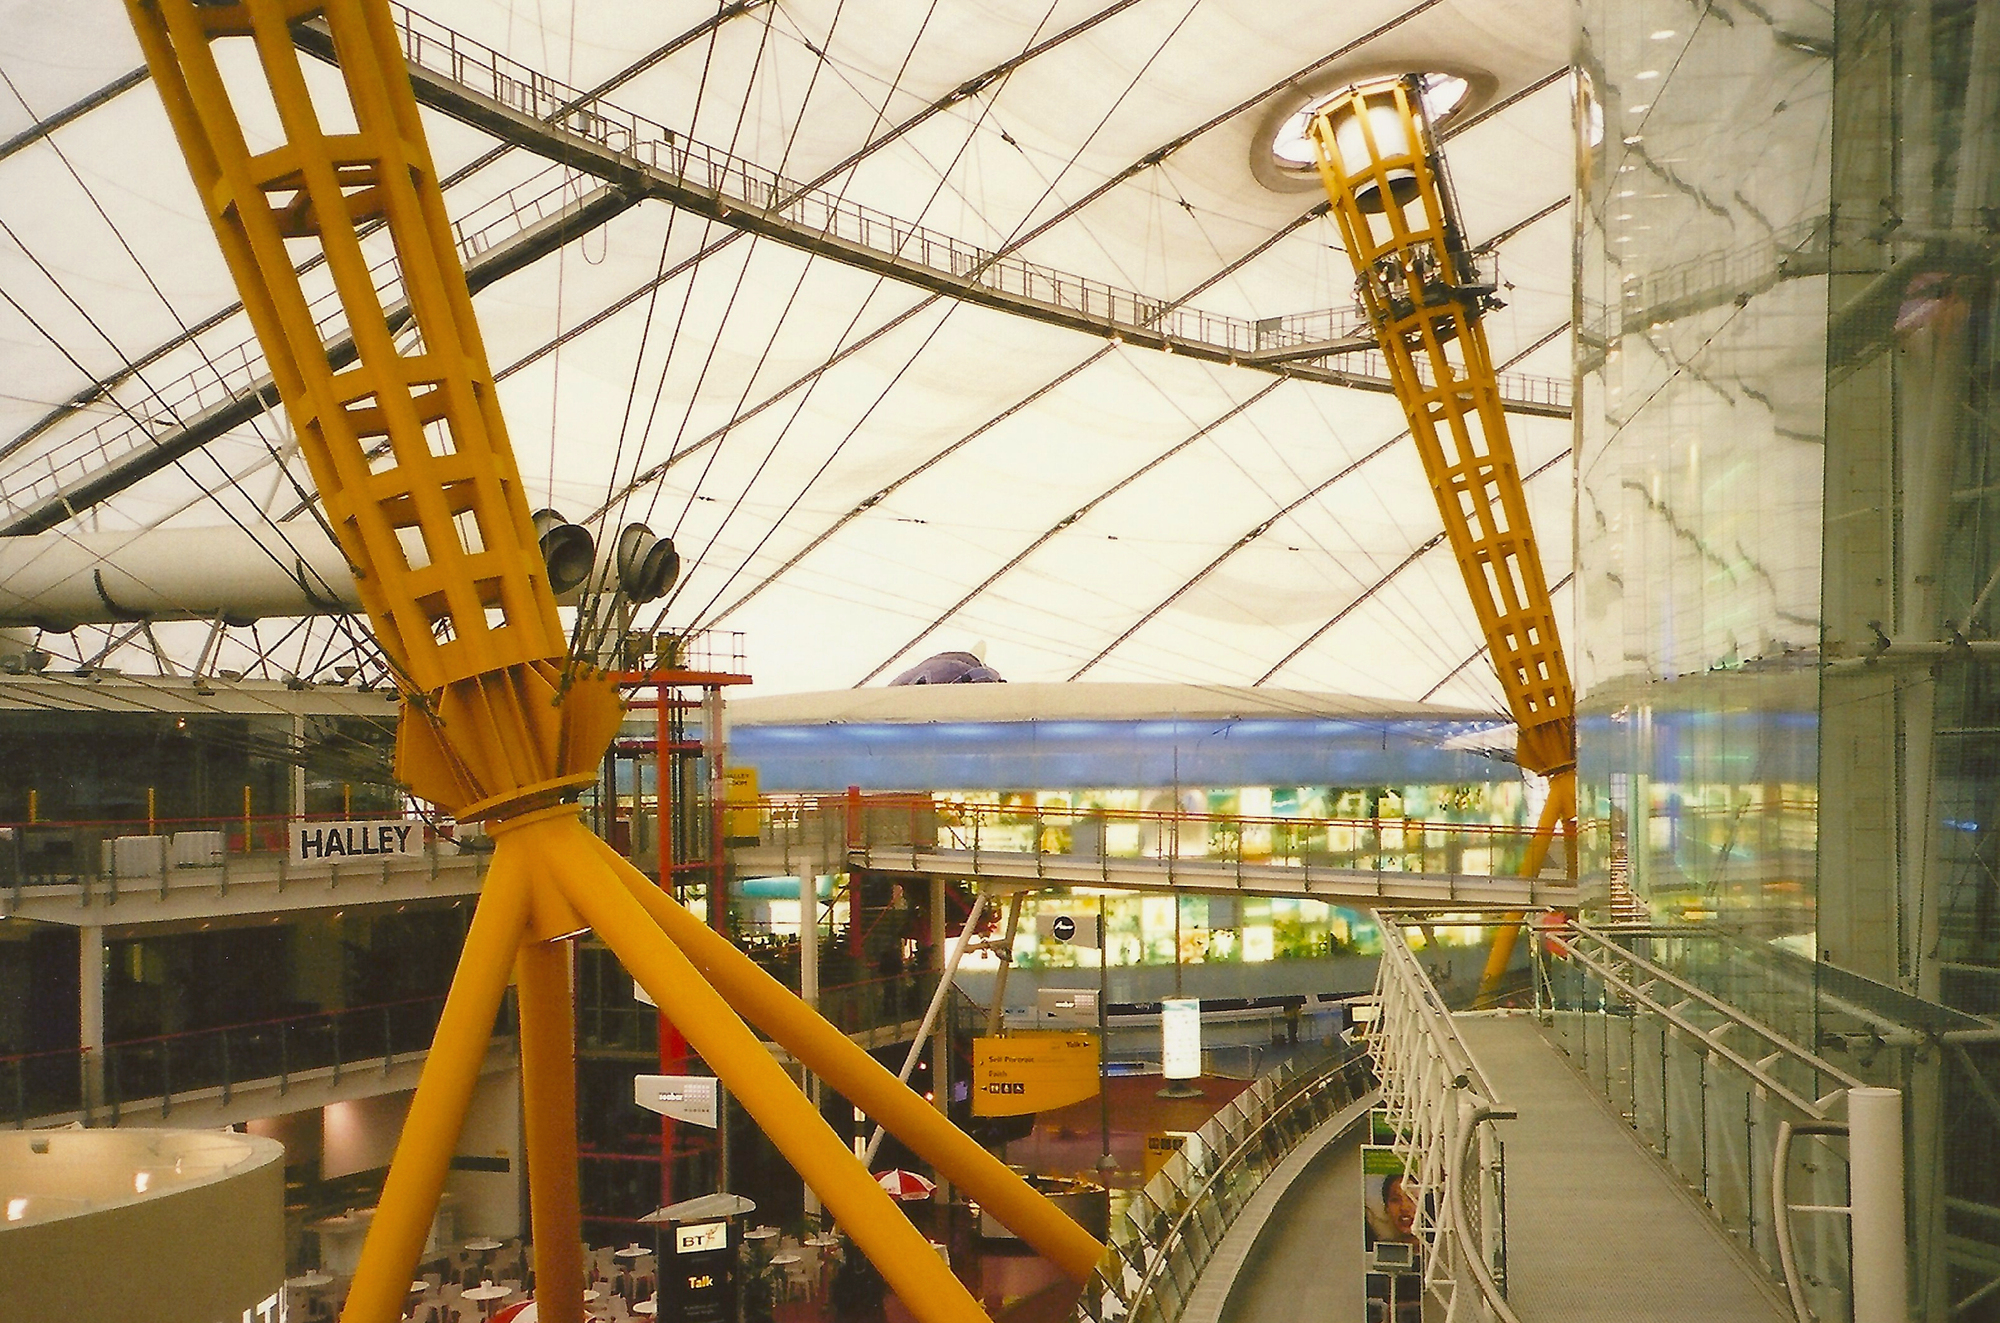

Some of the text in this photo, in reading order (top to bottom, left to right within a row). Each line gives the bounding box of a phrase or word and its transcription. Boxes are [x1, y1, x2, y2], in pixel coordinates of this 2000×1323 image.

[301, 825, 412, 859] HALLEY
[682, 1235, 705, 1248] BT
[687, 1275, 714, 1289] Talk
